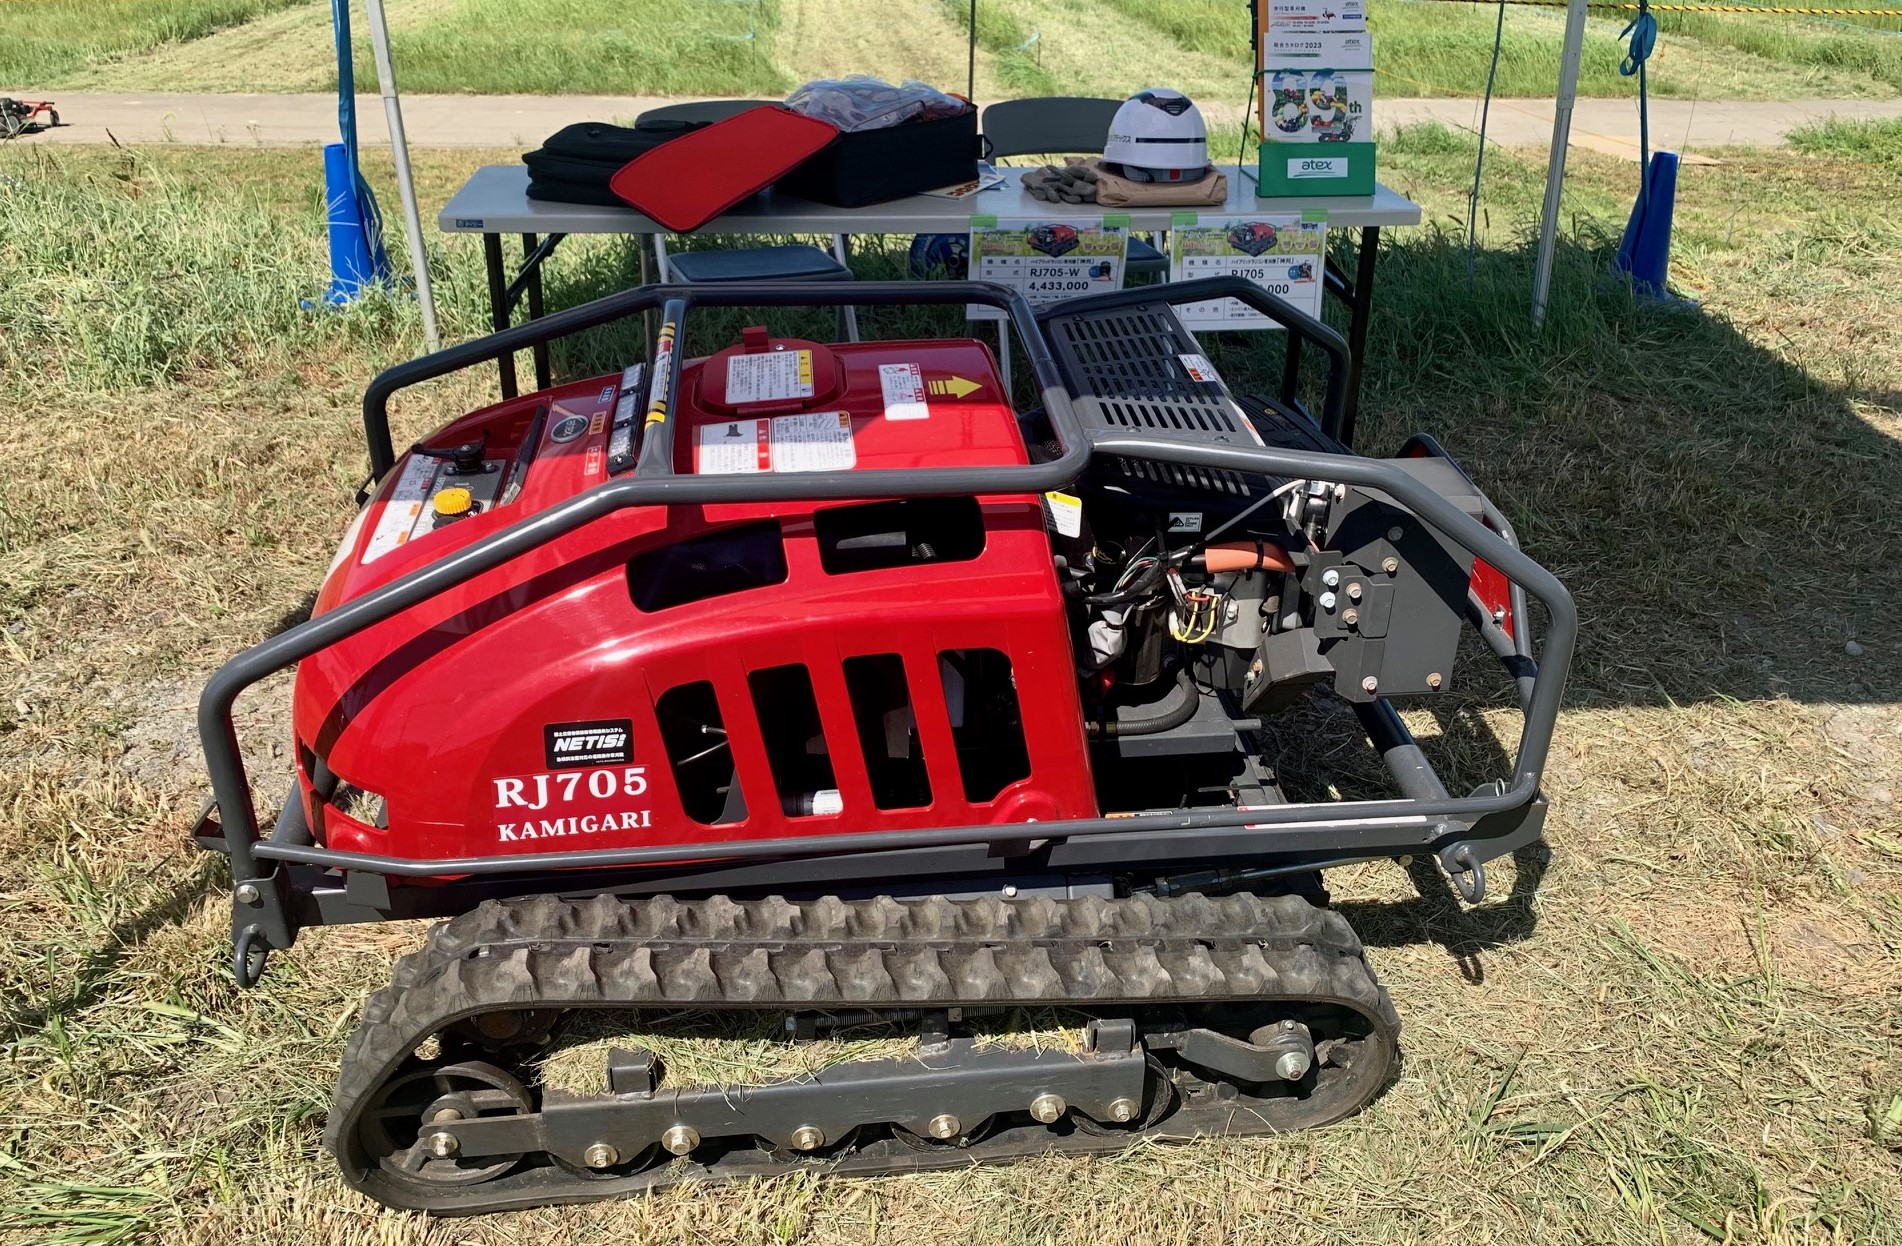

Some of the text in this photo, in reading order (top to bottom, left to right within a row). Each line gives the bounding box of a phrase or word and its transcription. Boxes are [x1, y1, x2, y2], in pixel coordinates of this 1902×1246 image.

[1301, 159, 1333, 171] atex
[1030, 268, 1080, 277] RJ705-W
[1029, 281, 1089, 292] 4,433,000
[493, 767, 648, 810] RJ705
[497, 810, 652, 842] KAMIGARI
